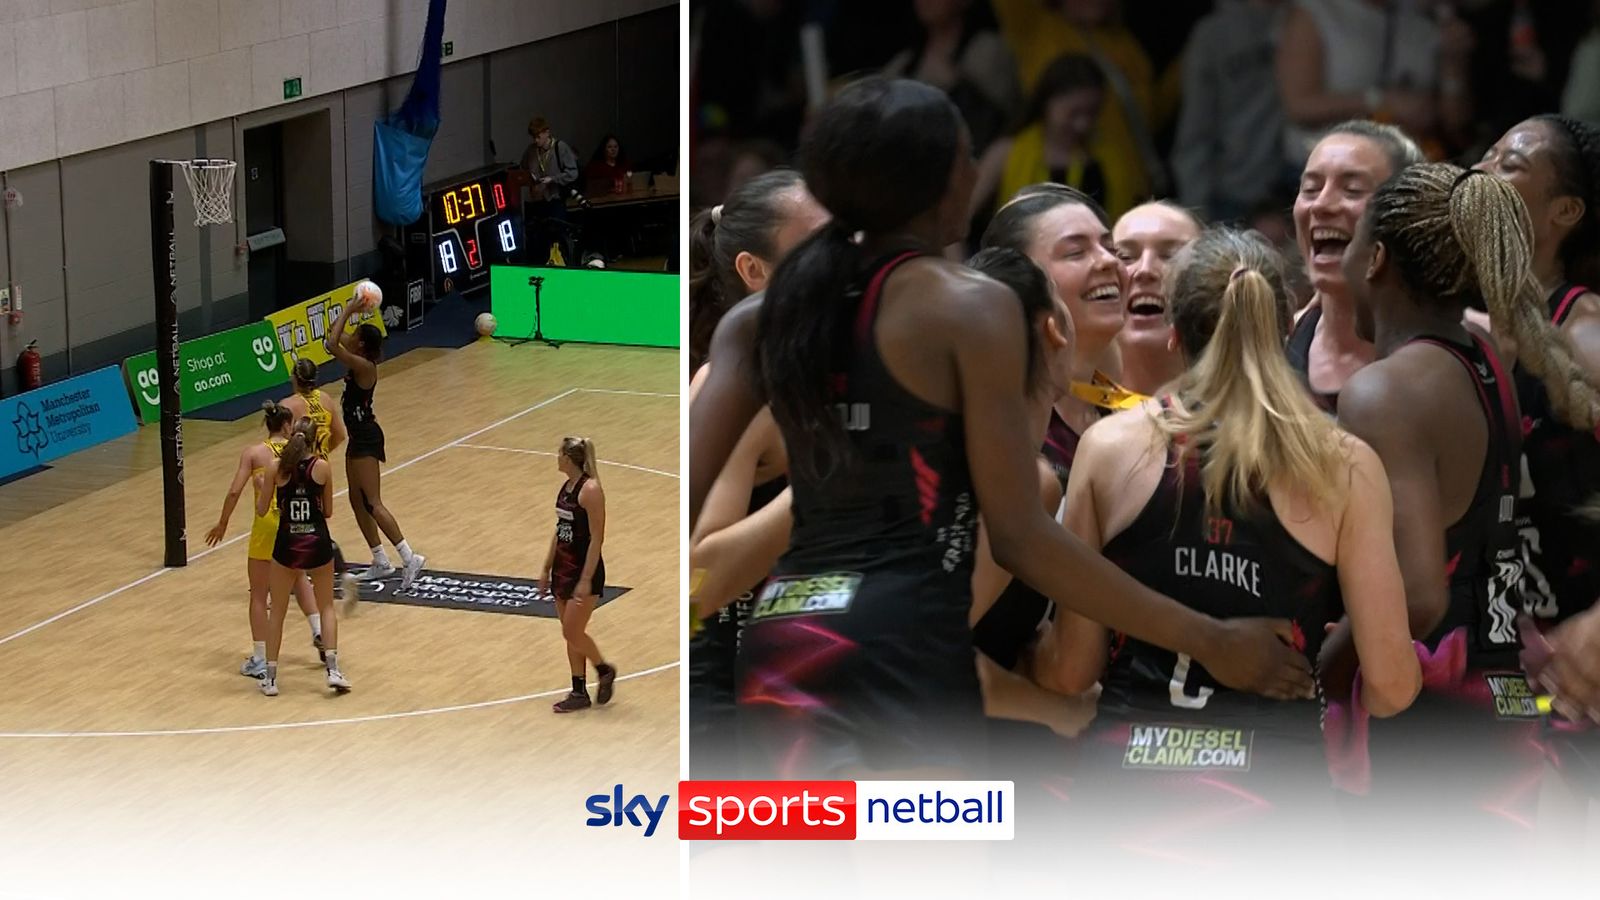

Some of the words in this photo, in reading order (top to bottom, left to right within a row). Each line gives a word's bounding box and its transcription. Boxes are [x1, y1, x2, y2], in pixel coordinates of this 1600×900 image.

[443, 184, 485, 224] 10:37
[494, 184, 506, 209] 0
[498, 219, 516, 252] 18
[438, 240, 458, 273] 18
[467, 239, 478, 266] 2
[252, 335, 274, 355] ao
[187, 356, 214, 373] Shop
[215, 351, 227, 365] at
[137, 367, 160, 389] ao
[194, 371, 232, 392] ao.com
[40, 388, 92, 413] Manchester
[45, 402, 101, 428] Metropolitan
[50, 422, 92, 443] University
[290, 500, 310, 521] GA
[1207, 518, 1233, 544] 37
[1174, 547, 1262, 598] CLARKE
[1131, 727, 1247, 750] MYDIESEL
[1128, 747, 1247, 767] CLAIM.COM
